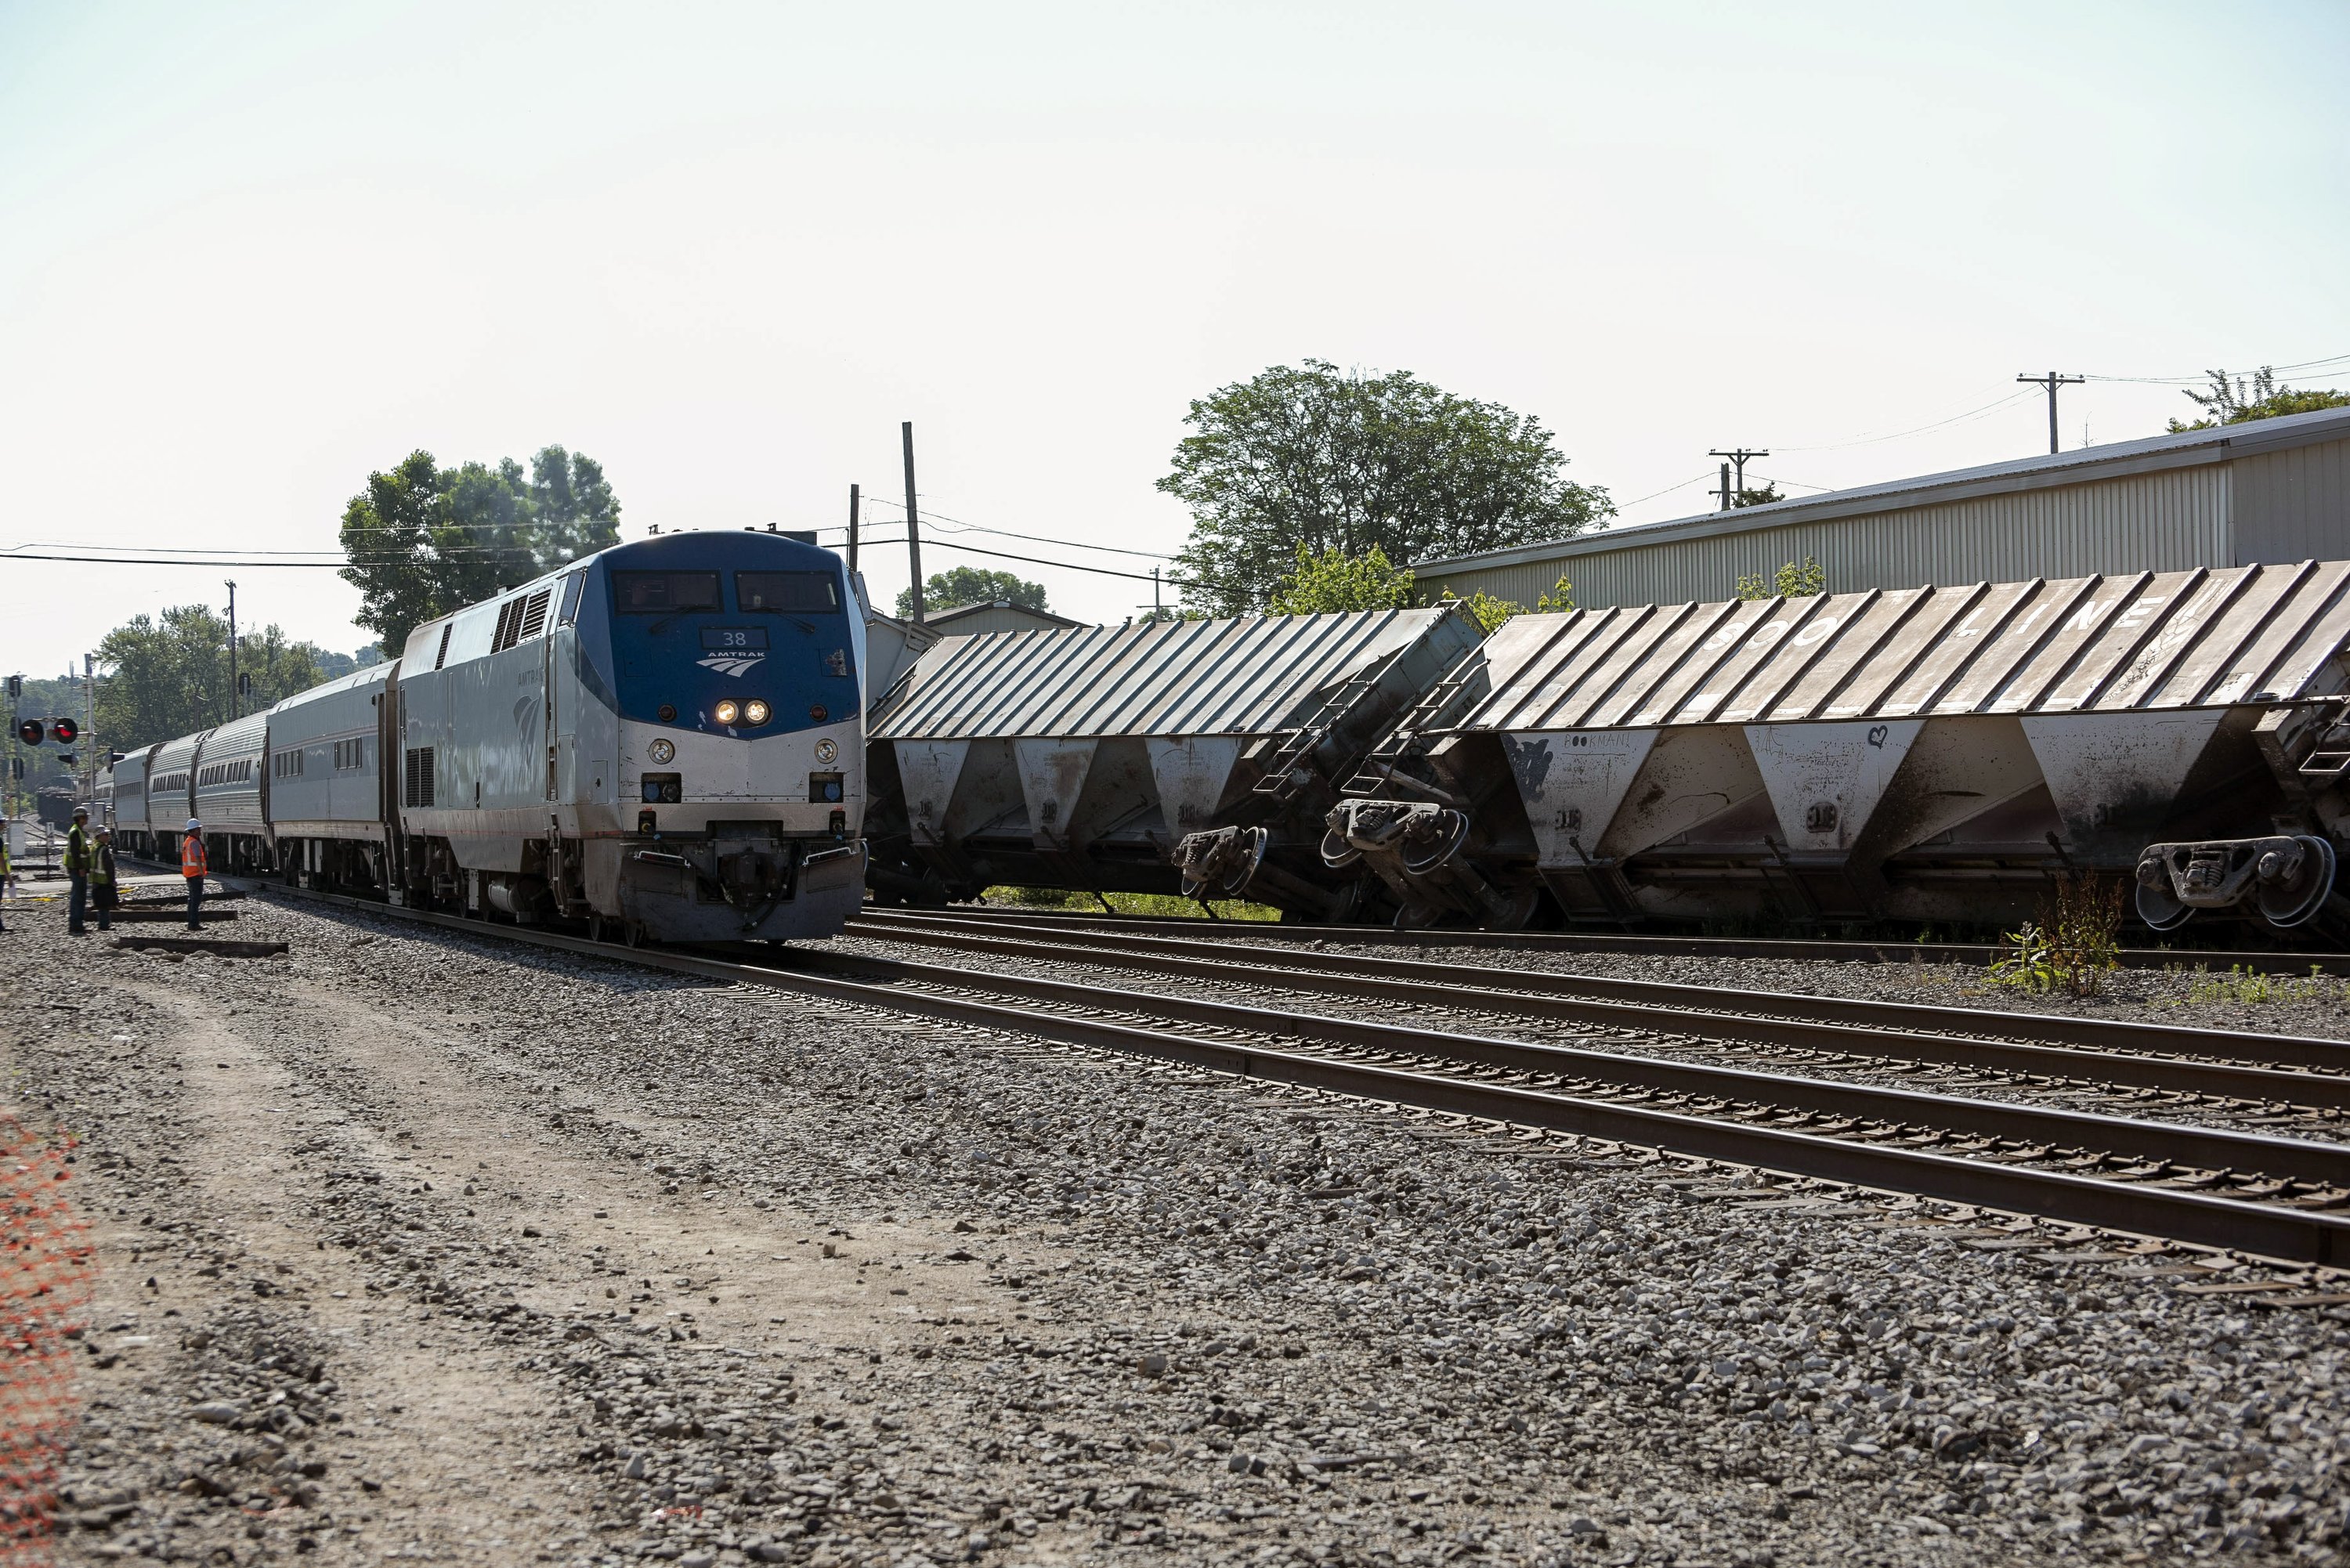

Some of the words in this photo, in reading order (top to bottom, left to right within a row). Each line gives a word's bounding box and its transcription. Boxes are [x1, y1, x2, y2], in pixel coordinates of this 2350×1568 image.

[723, 632, 747, 646] 38
[1702, 616, 1838, 651] SOO
[1953, 596, 2167, 638] LINE
